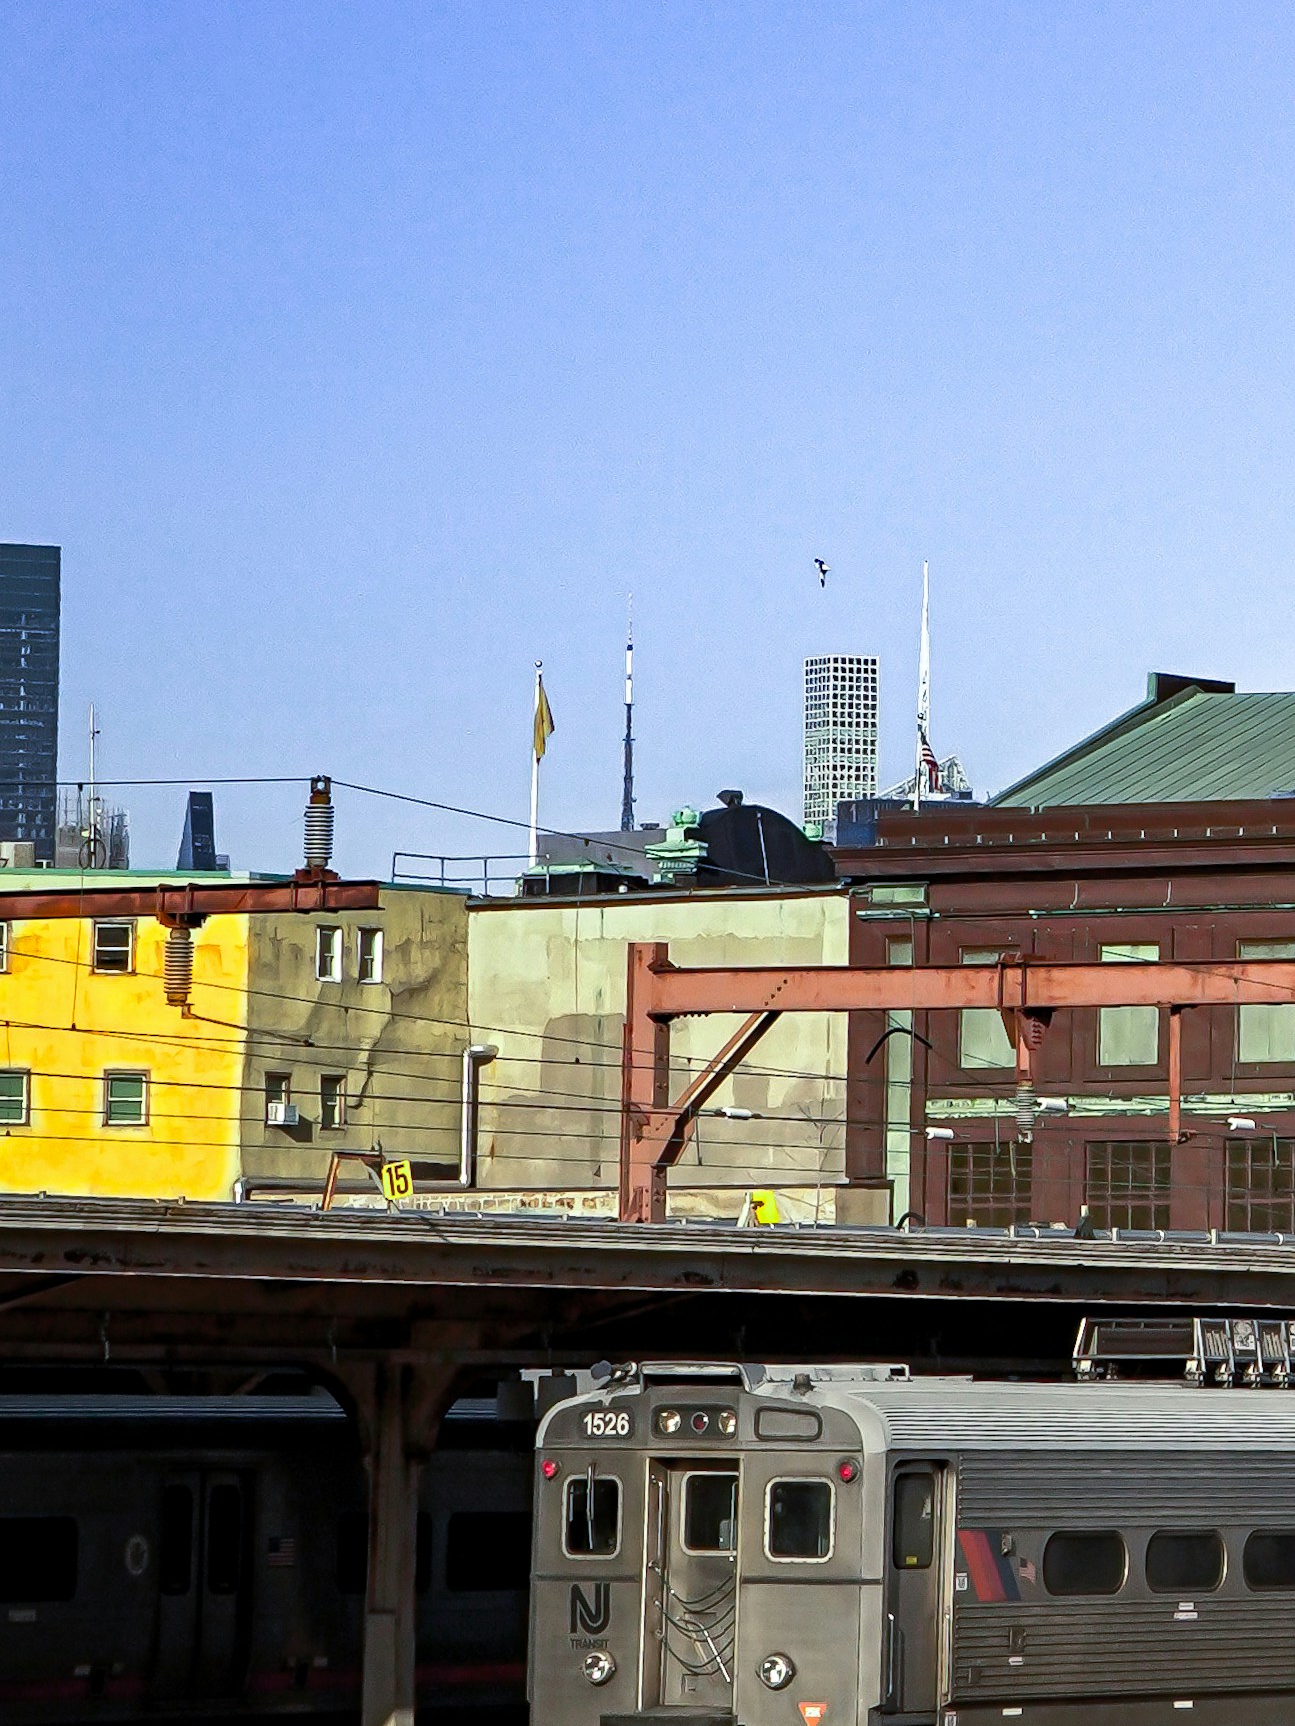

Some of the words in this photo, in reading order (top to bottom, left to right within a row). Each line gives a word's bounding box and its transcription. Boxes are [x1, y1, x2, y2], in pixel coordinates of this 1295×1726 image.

[386, 1164, 409, 1196] 15
[583, 1412, 630, 1436] 1526
[570, 1638, 610, 1650] TRANSIT
